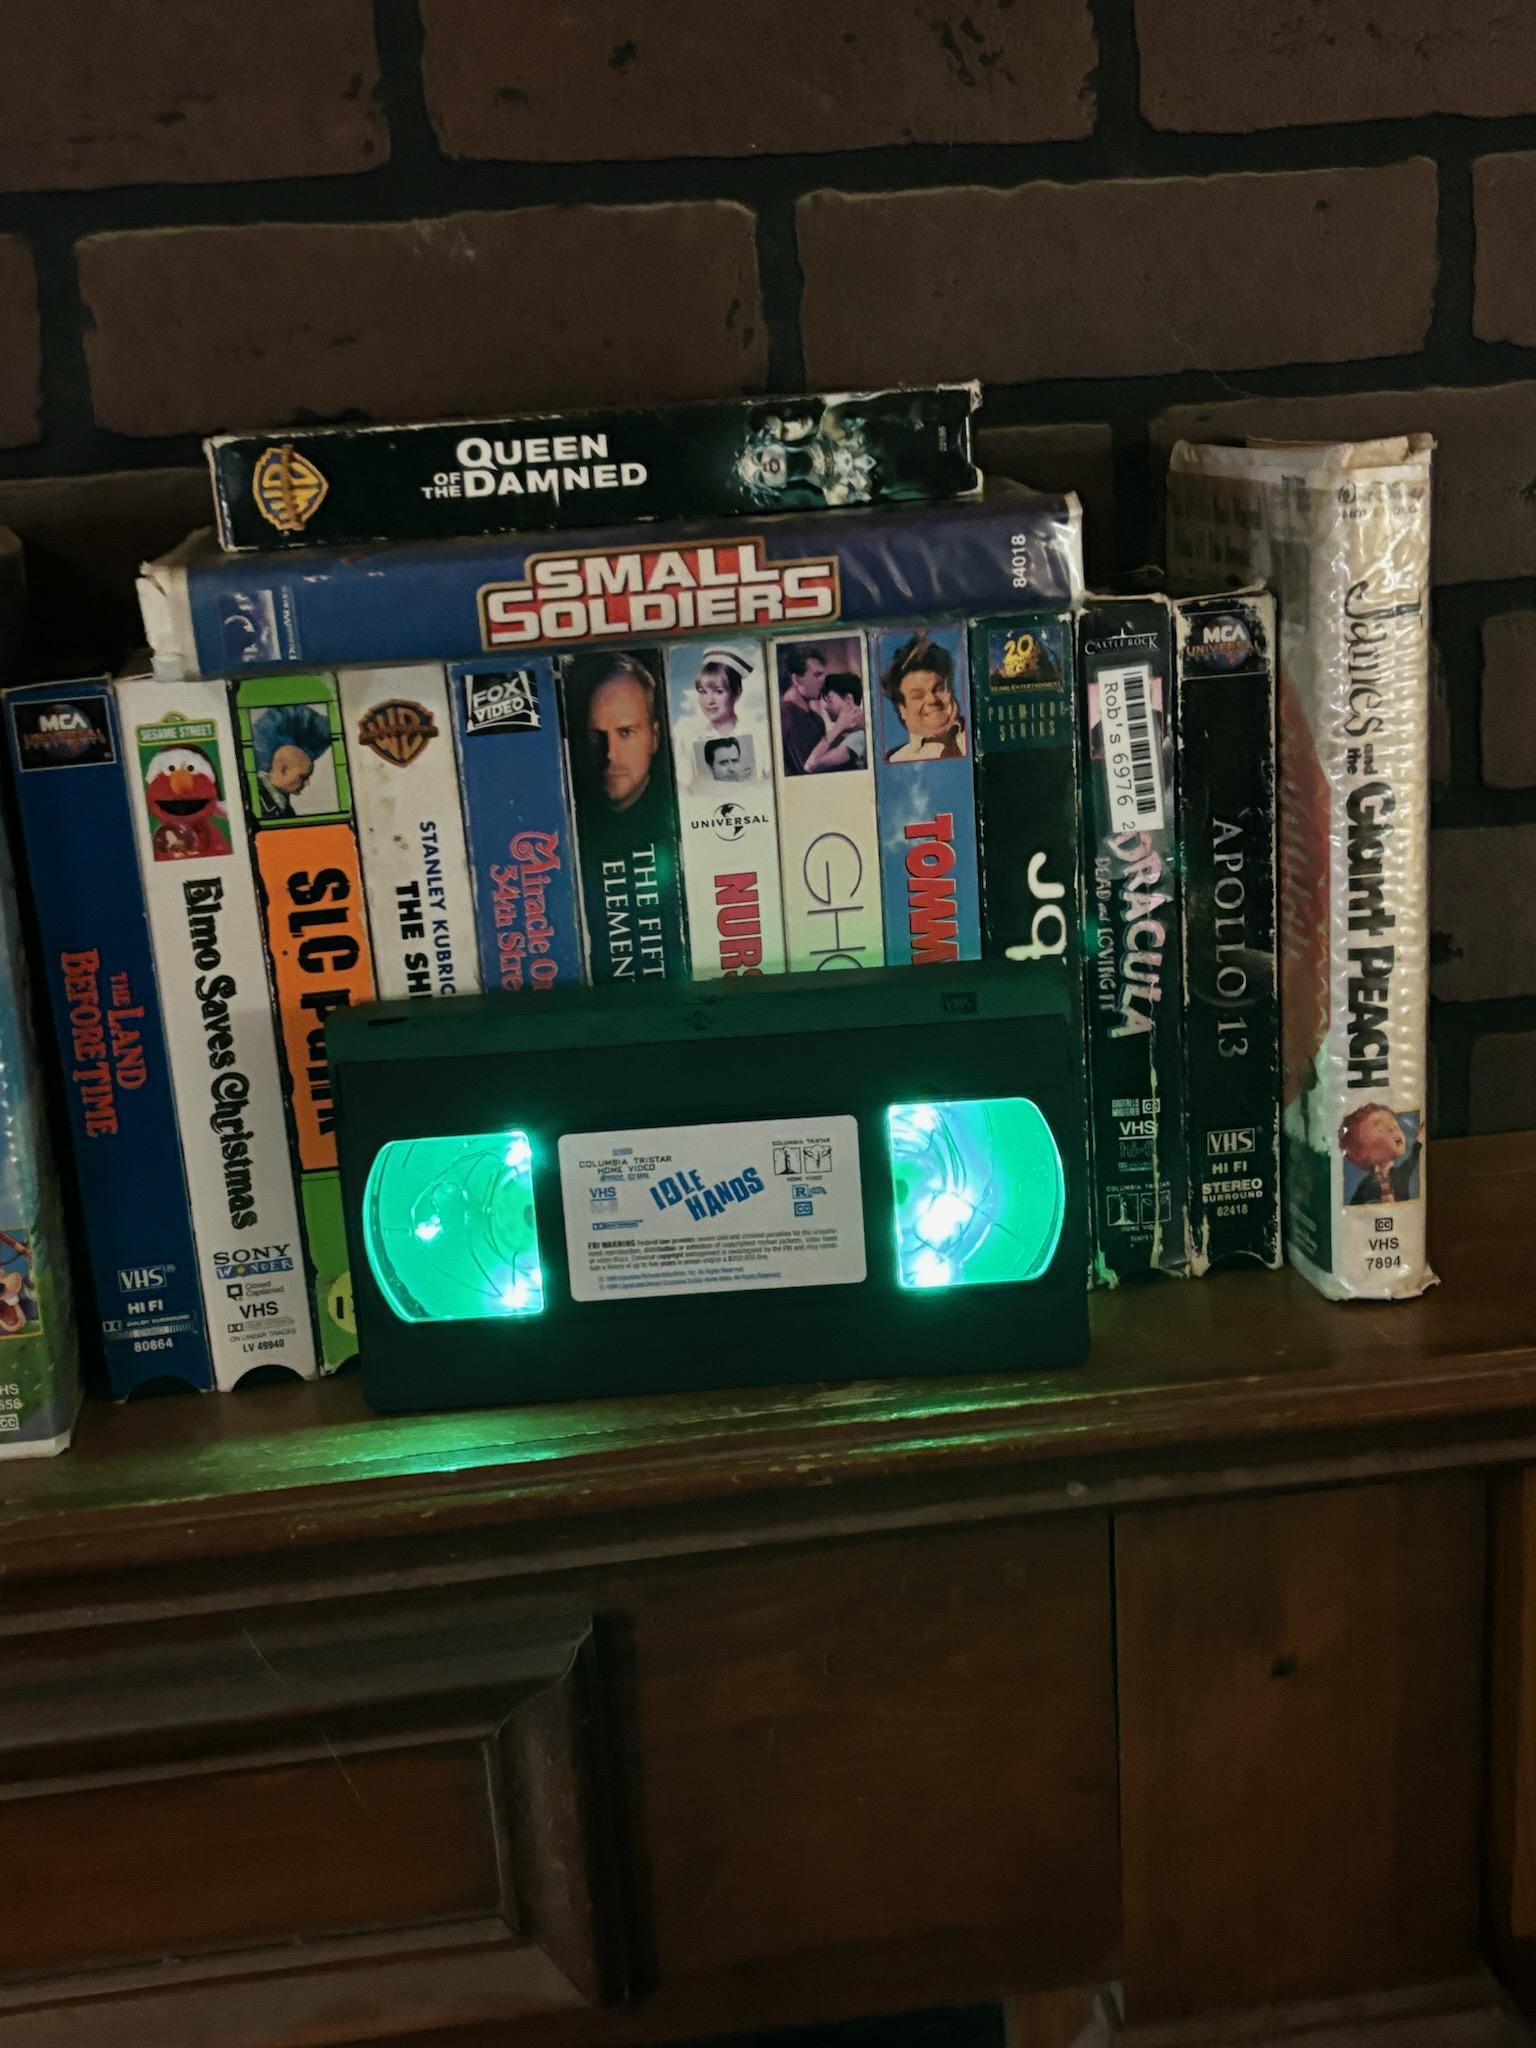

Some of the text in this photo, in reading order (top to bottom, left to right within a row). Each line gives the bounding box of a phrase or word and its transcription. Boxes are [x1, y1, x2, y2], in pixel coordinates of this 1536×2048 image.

[456, 434, 608, 471] QUEEN
[422, 463, 648, 507] THE DAMNED
[433, 472, 461, 486] OF
[535, 545, 780, 600] SMALL
[1011, 533, 1028, 589] 84018
[488, 565, 833, 644] SOLDIERS
[1203, 624, 1248, 644] MCA
[1344, 580, 1421, 737] James
[472, 676, 525, 722] FOX VIDEO
[1104, 681, 1122, 745] Rob's
[39, 713, 88, 732] MCA
[140, 724, 213, 741] SESAME STREET
[1112, 752, 1134, 807] 6976
[1346, 747, 1362, 775] the
[691, 814, 769, 830] UNIVERSAL
[419, 821, 446, 911] STANLEY
[632, 843, 657, 907] THE
[1346, 781, 1396, 936] Giant
[396, 880, 425, 940] THE
[510, 830, 561, 954] Miracle
[287, 868, 360, 974] SLC
[602, 860, 635, 983] ELEMEN
[1104, 831, 1167, 1039] DRACULA
[1213, 817, 1249, 1058] APOLLO 13
[107, 971, 148, 1090] THE LAND
[1347, 944, 1395, 1088] PEACH
[61, 948, 119, 1138] BEFORE TIME
[183, 877, 258, 1230] Elmo Saves Christmas
[1120, 1120, 1157, 1135] VHS
[1210, 1131, 1253, 1153] VHS
[579, 1155, 672, 1169] COLUMBIA TRISTAR
[598, 1164, 655, 1174] HOME VIDEO
[1212, 1160, 1248, 1174] HI FI
[589, 1186, 617, 1198] VHS
[650, 1169, 706, 1210] IDLE
[685, 1167, 765, 1222] HANDS
[1202, 1178, 1263, 1195] STEREO
[1202, 1190, 1263, 1204] SURROUND
[213, 1243, 291, 1266] SONY
[1365, 1255, 1401, 1270] 7894
[1368, 1237, 1399, 1251] VHS
[120, 1267, 164, 1290] VHS
[127, 1299, 164, 1315] HI FI
[239, 1301, 279, 1319] VHS
[134, 1337, 175, 1353] 80864
[243, 1343, 255, 1353] LV
